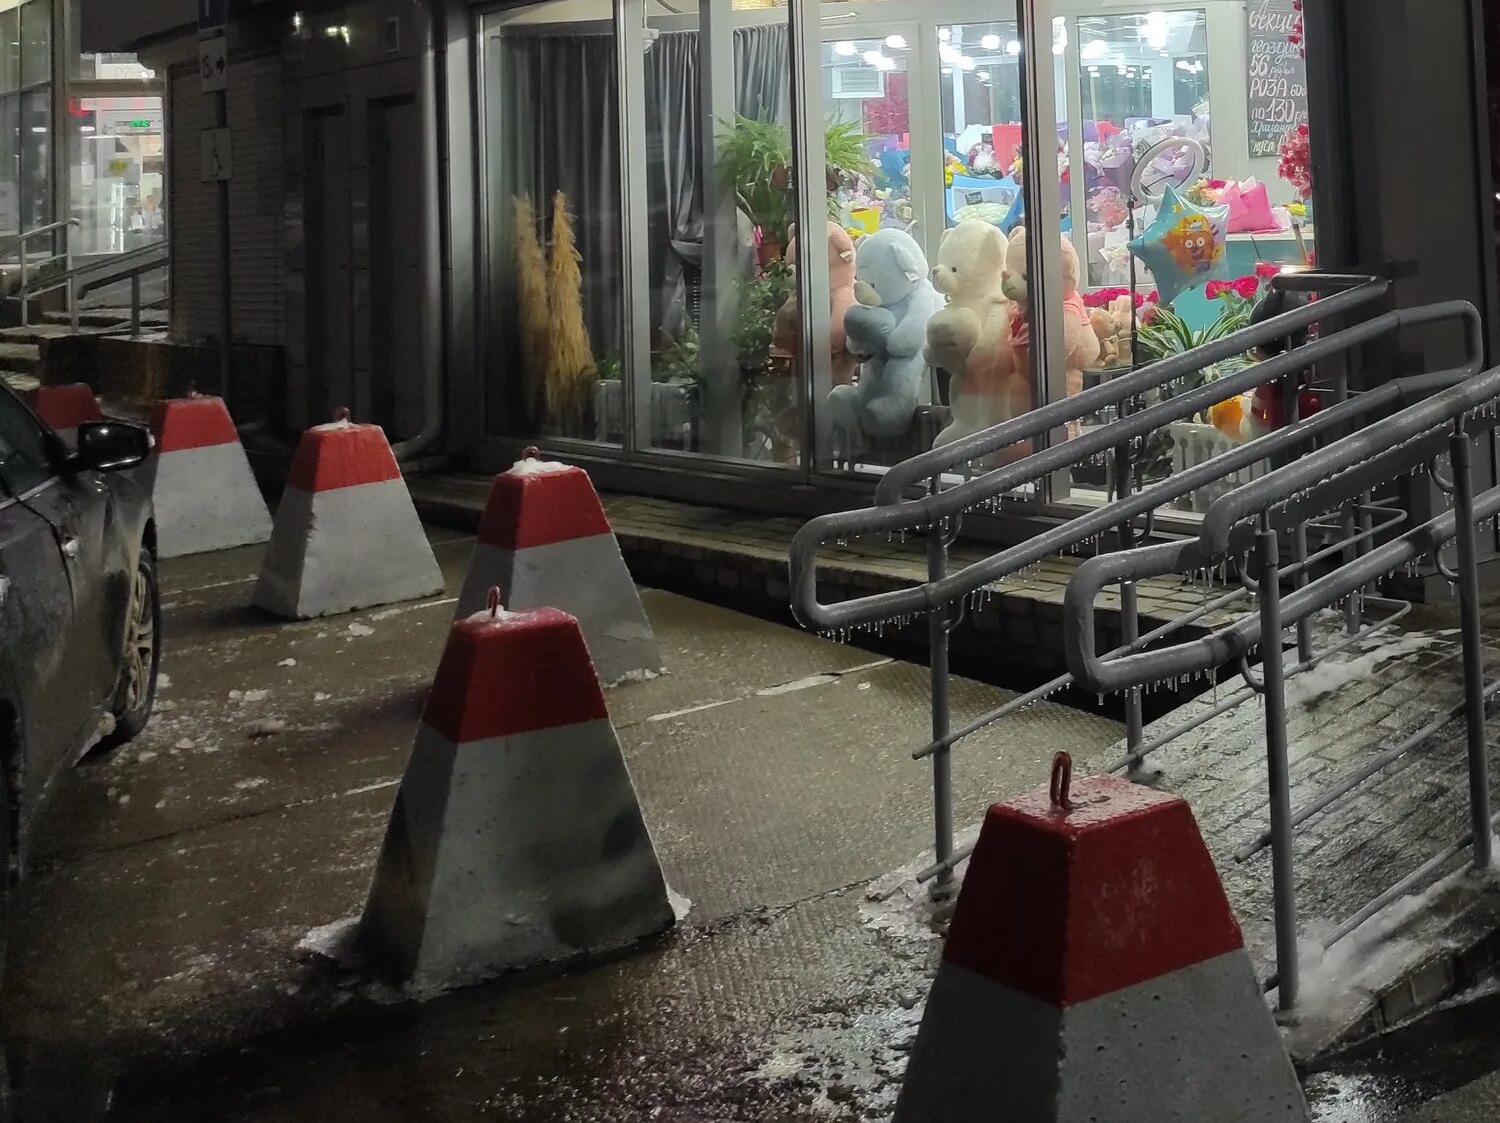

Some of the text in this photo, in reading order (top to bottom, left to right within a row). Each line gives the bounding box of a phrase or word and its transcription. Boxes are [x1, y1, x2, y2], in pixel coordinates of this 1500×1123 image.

[1249, 0, 1300, 33] Акци
[1249, 53, 1270, 77] 56
[1265, 98, 1295, 123] 130
